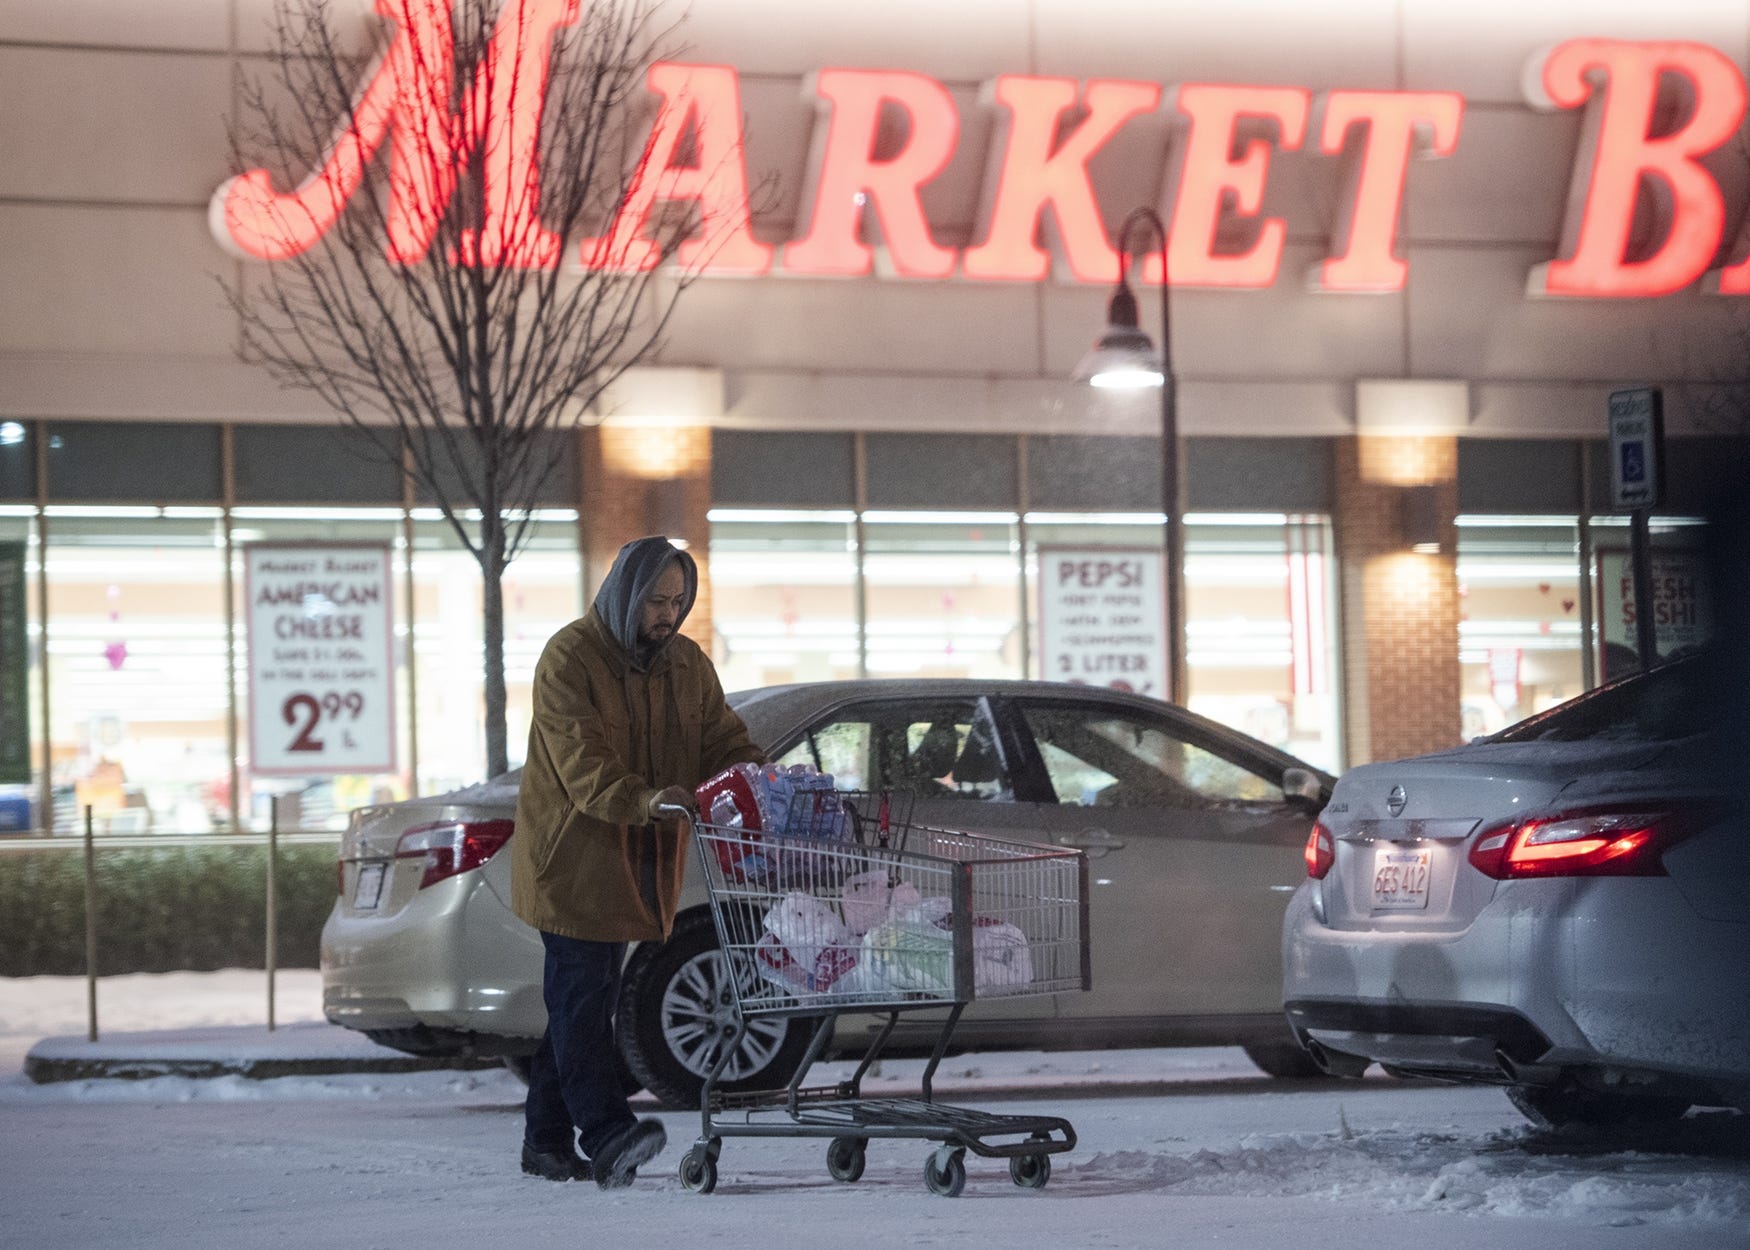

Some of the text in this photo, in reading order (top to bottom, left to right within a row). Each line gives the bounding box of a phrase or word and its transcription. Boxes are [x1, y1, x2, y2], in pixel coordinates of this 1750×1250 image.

[222, 0, 1750, 298] MARKET B
[1058, 560, 1144, 588] PEPSI
[1621, 577, 1696, 600] FESH
[273, 614, 363, 640] CHEESE
[1622, 602, 1696, 626] SSHI
[1402, 866, 1426, 894] 412
